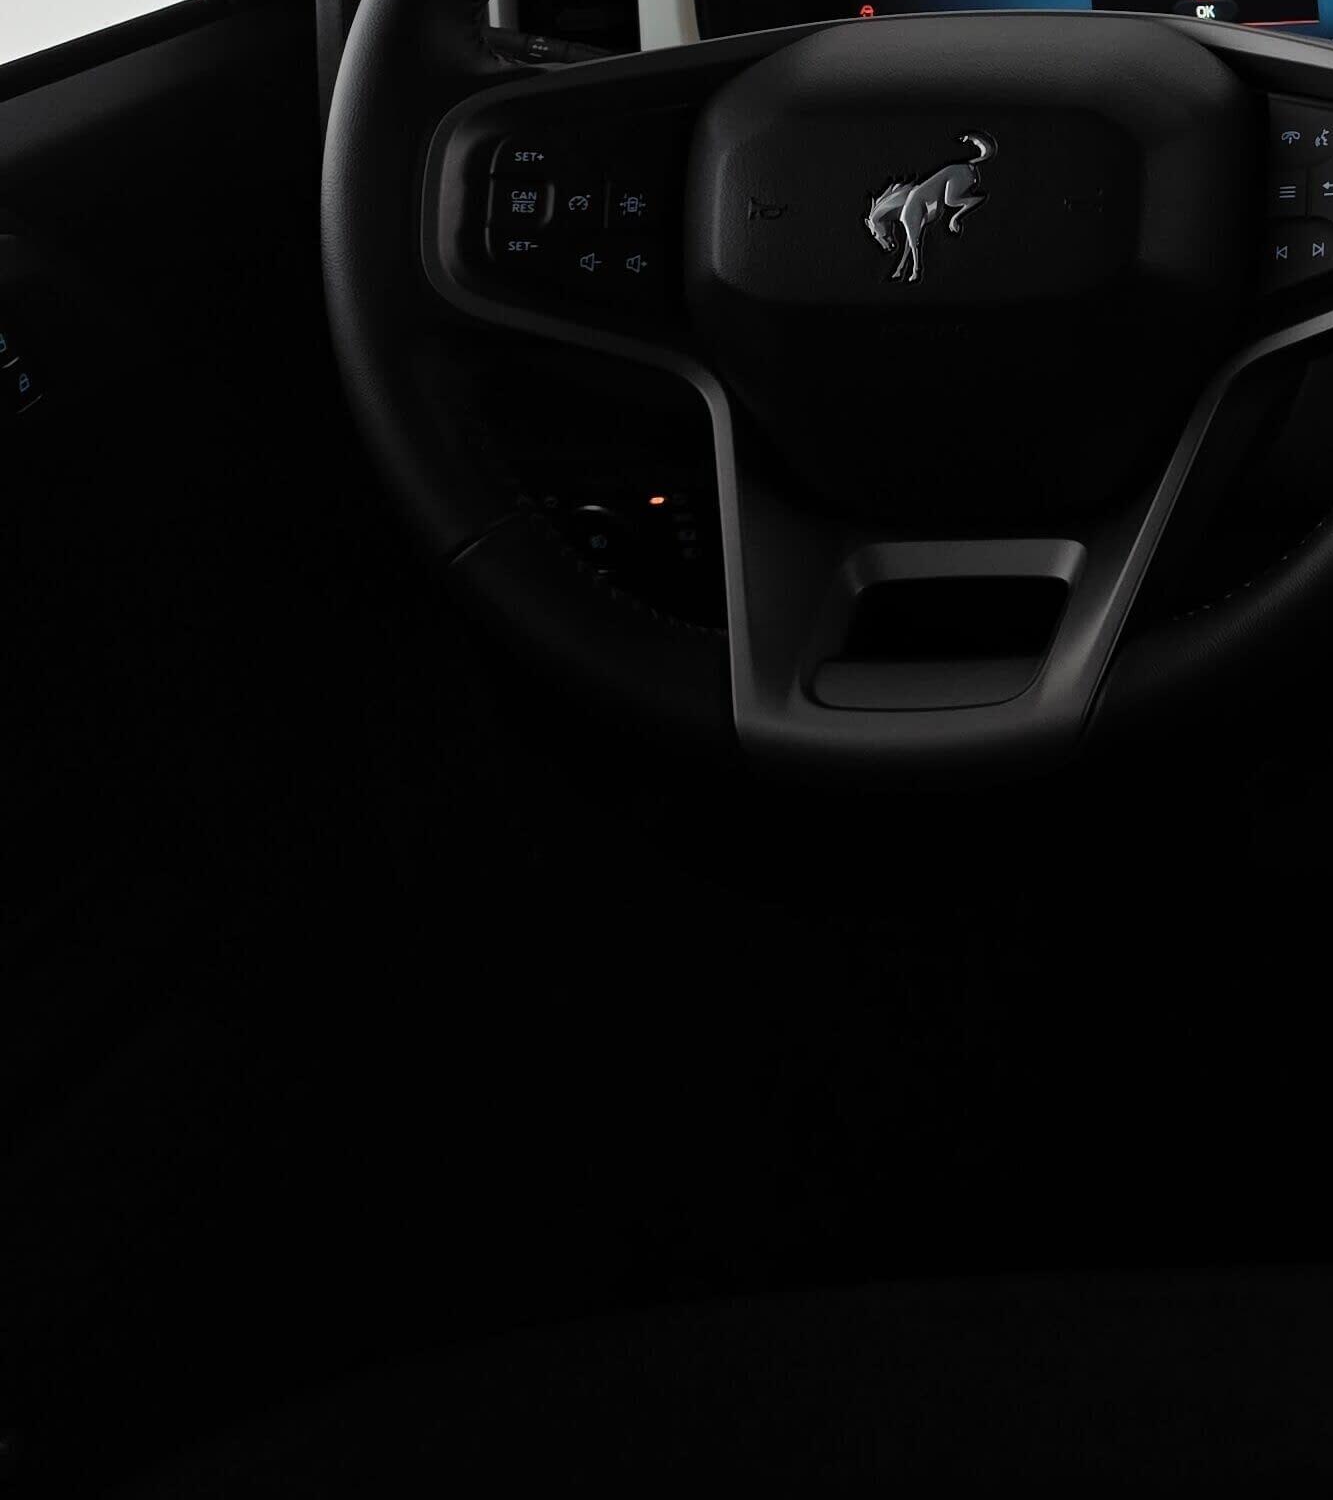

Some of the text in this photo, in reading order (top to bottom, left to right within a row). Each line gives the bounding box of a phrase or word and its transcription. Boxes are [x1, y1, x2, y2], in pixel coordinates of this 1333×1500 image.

[1196, 5, 1215, 18] OK
[511, 190, 537, 200] CAN
[512, 202, 535, 213] RES
